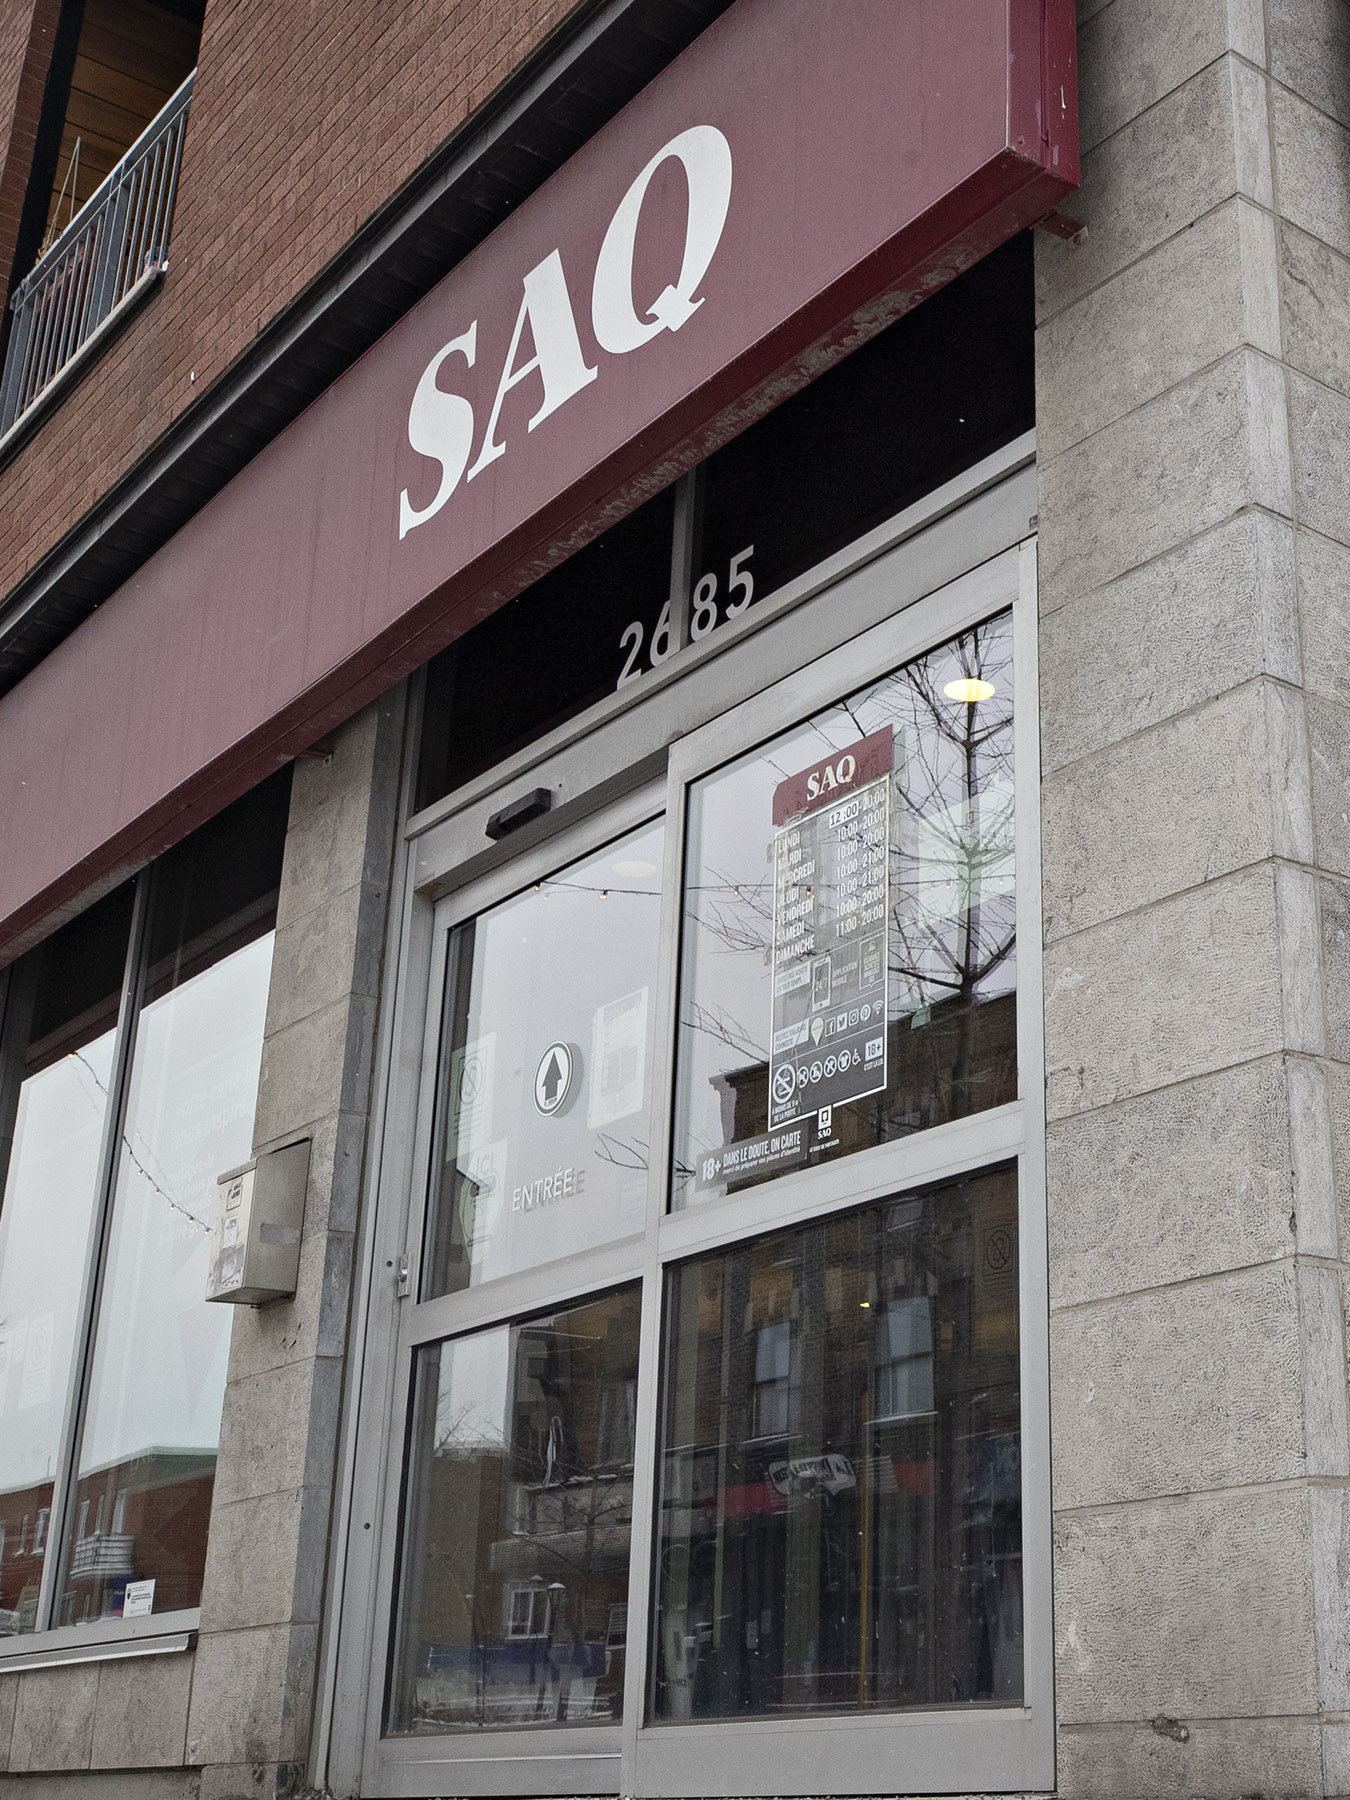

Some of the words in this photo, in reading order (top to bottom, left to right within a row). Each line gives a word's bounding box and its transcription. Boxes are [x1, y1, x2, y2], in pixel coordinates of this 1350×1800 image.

[399, 125, 733, 541] SAQ
[616, 544, 754, 691] 2685
[807, 755, 856, 801] SAQ
[778, 848, 801, 871] MRDI
[778, 860, 815, 889] MRCREDI
[777, 899, 814, 926] VENDREDI
[776, 921, 804, 945] SAMEDI
[776, 934, 815, 964] DIMANCHE
[867, 1042, 882, 1057] 18+
[723, 1150, 740, 1167] DANS
[740, 1149, 747, 1162] LE
[771, 1137, 780, 1152] ON
[781, 1130, 801, 1148] CARTE
[702, 1158, 721, 1180] 18+
[512, 1166, 574, 1212] ENTRÉE
